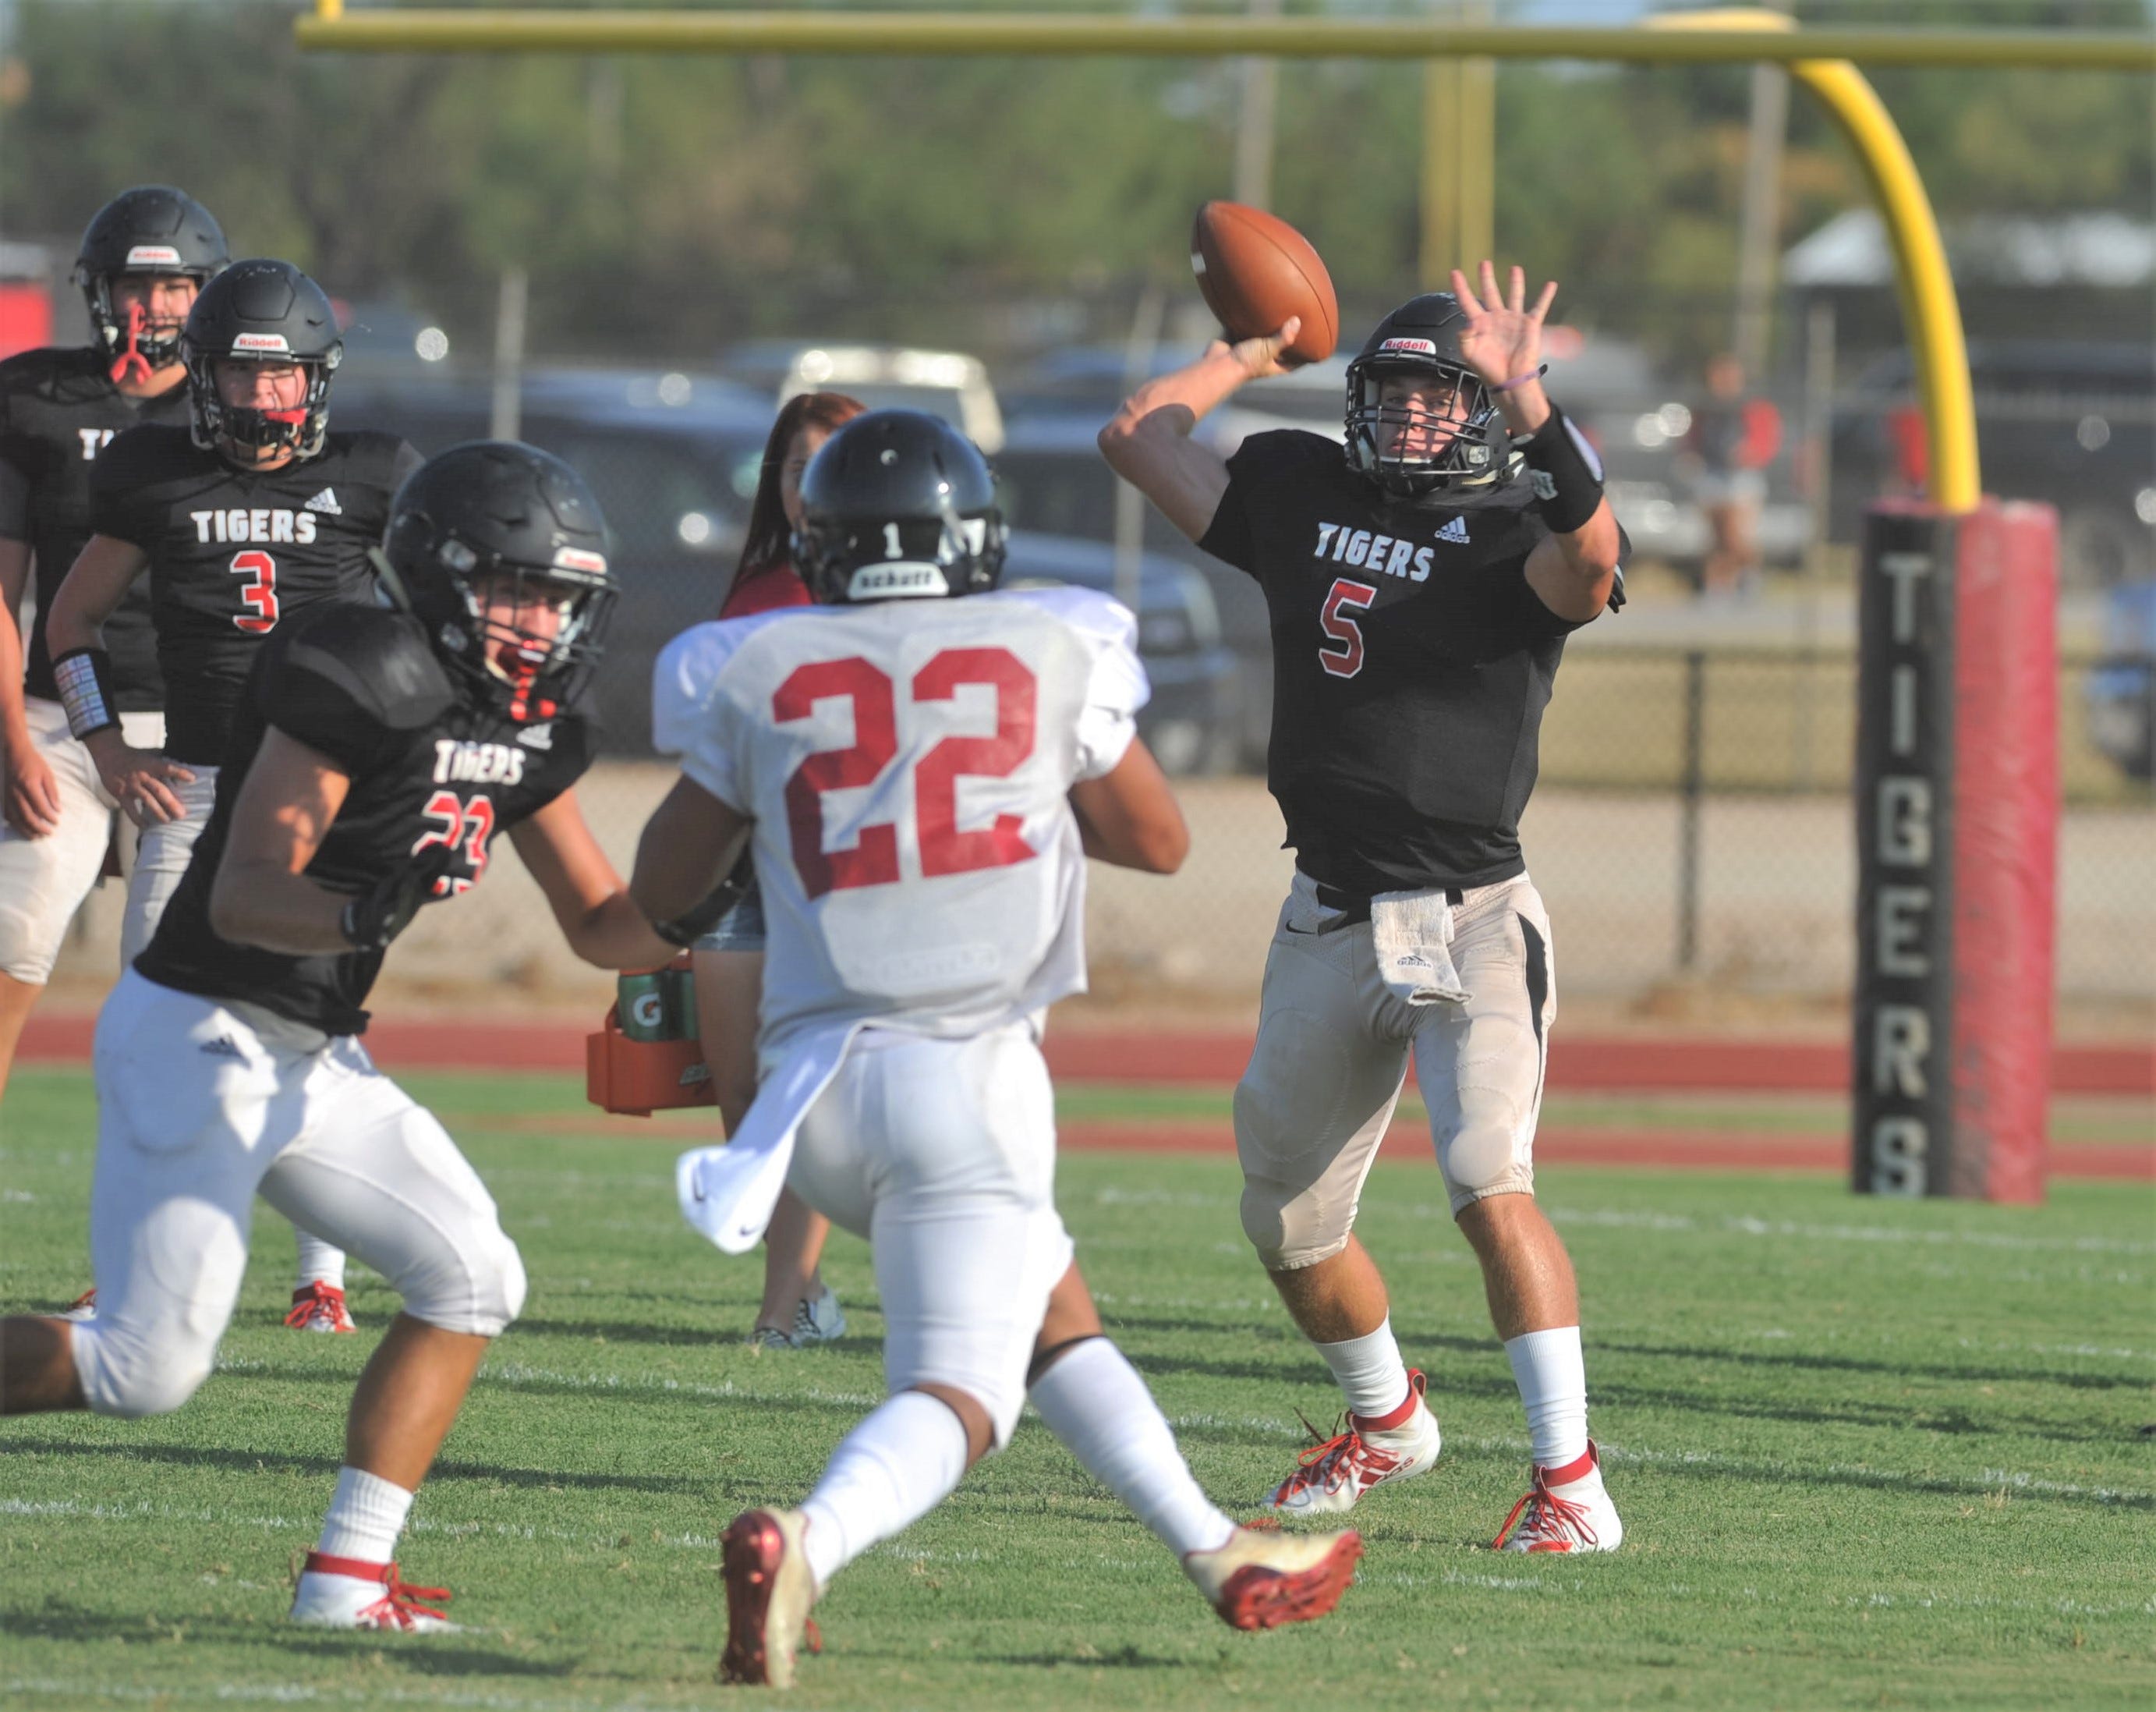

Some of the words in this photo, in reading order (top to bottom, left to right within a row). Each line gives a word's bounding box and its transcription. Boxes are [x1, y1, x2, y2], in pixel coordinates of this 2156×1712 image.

[1385, 339, 1428, 351] Riddell
[189, 509, 317, 544] TIGERS
[883, 523, 903, 559] 1
[1314, 521, 1436, 583] TIGERS
[229, 550, 280, 635] 3
[1319, 577, 1378, 679] 5
[770, 645, 1039, 902] 22
[1872, 551, 1931, 1200] TIGERS
[632, 992, 663, 1027] G
